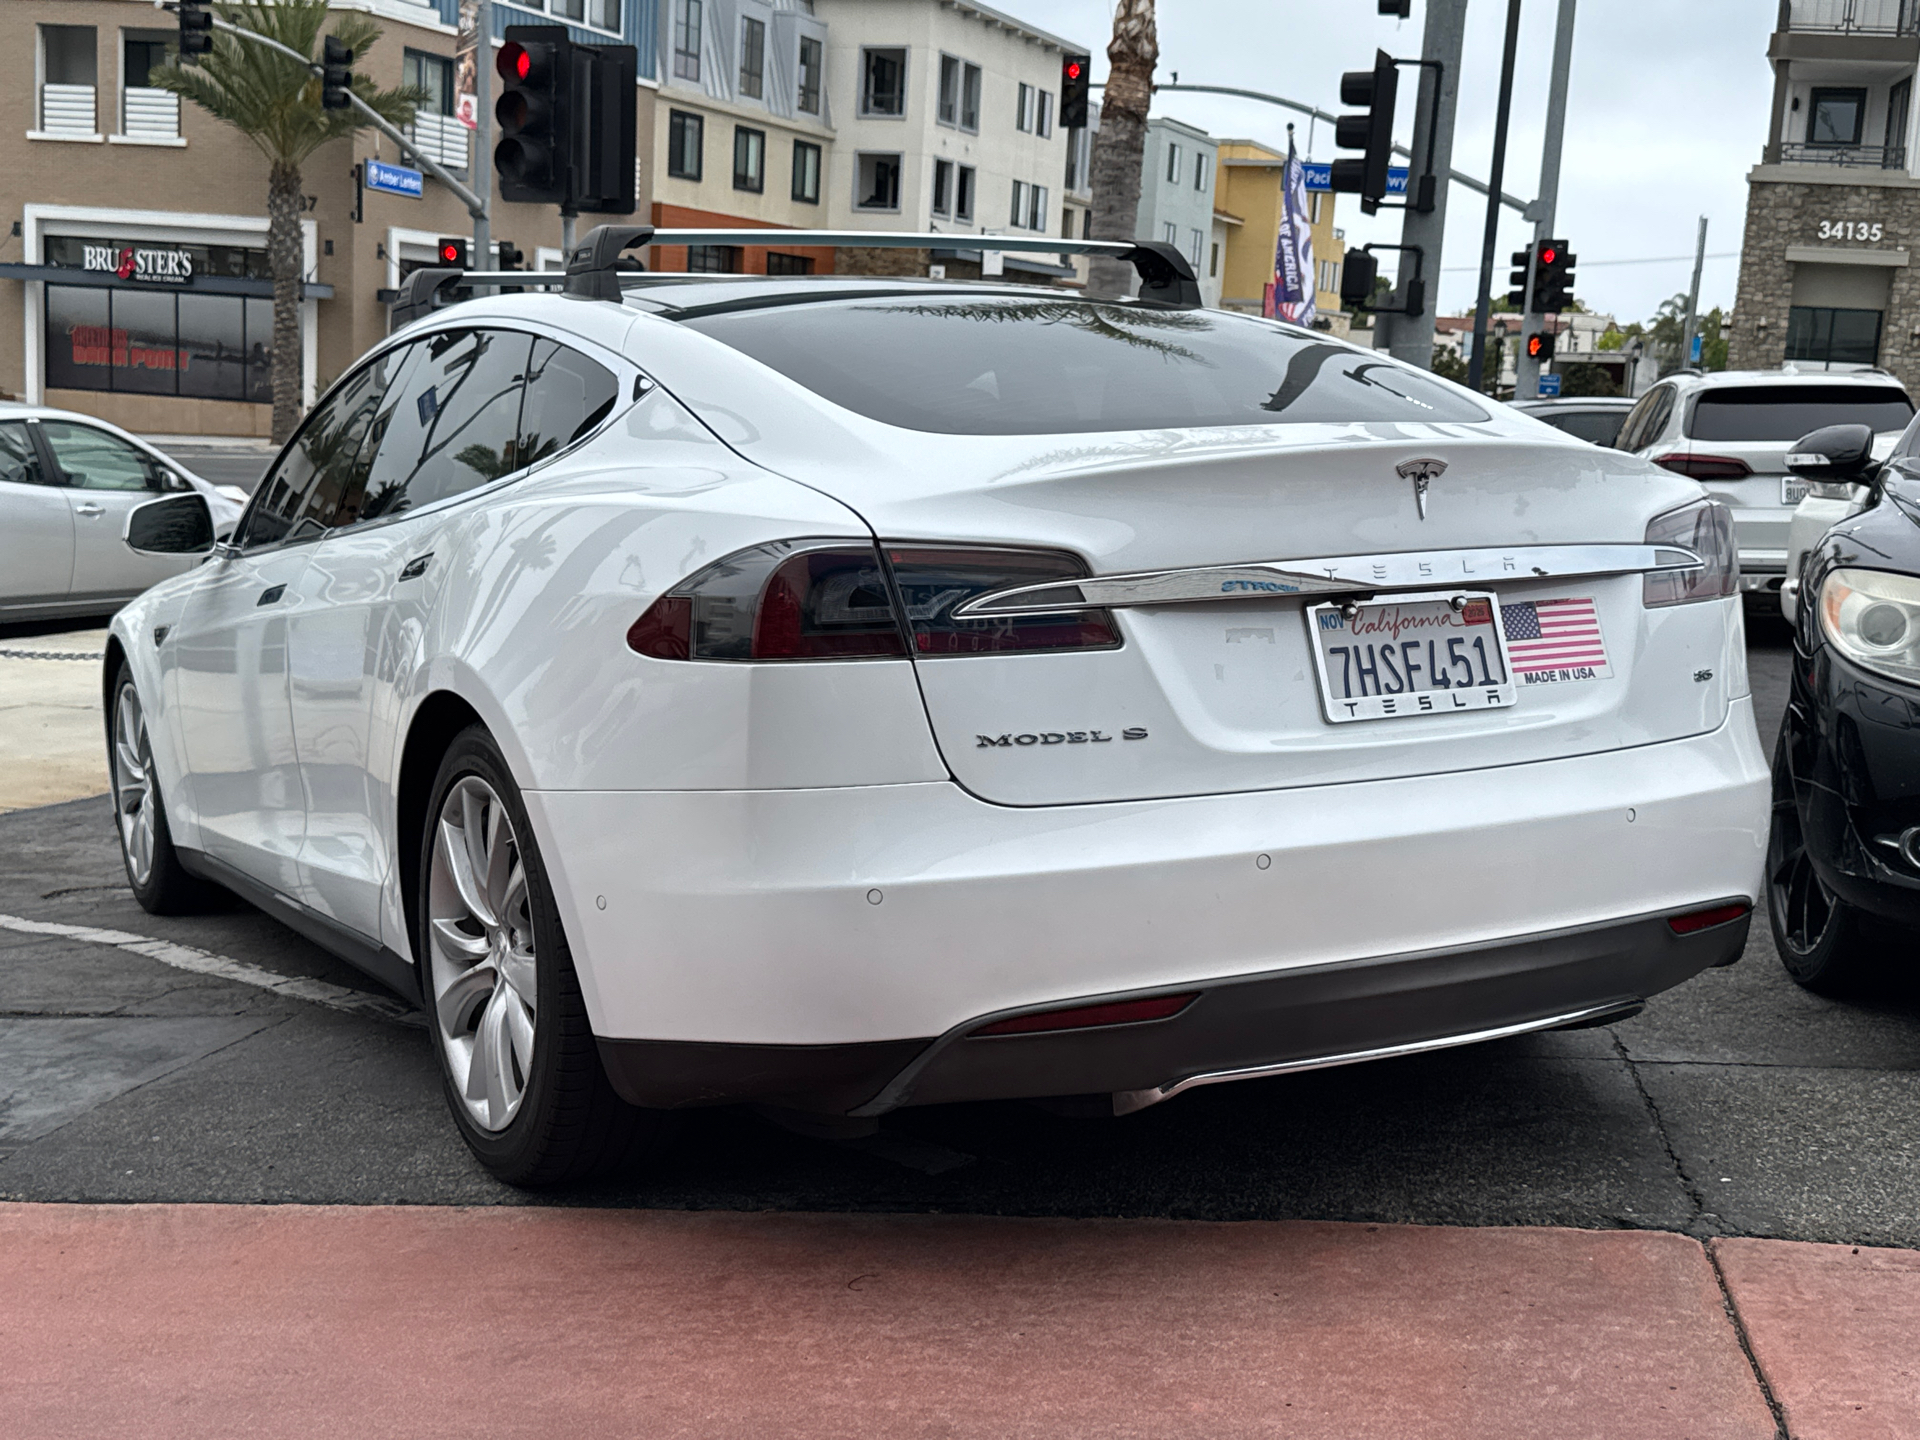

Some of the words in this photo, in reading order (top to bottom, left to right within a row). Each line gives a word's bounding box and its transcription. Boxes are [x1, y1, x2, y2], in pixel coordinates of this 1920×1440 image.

[379, 169, 400, 187] Amber
[1306, 169, 1331, 185] Paci
[1388, 177, 1408, 191] wy
[1818, 221, 1883, 242] 34135
[1323, 556, 1516, 581] TESLA
[1319, 613, 1345, 630] NOV
[1351, 606, 1465, 640] California
[1329, 636, 1499, 699] 7HSF451
[1524, 670, 1557, 685] MADE
[1559, 669, 1572, 682] IN
[1572, 667, 1597, 681] USA
[1343, 690, 1501, 717] TESLA
[975, 730, 1113, 748] MODEL
[1122, 725, 1149, 741] S
